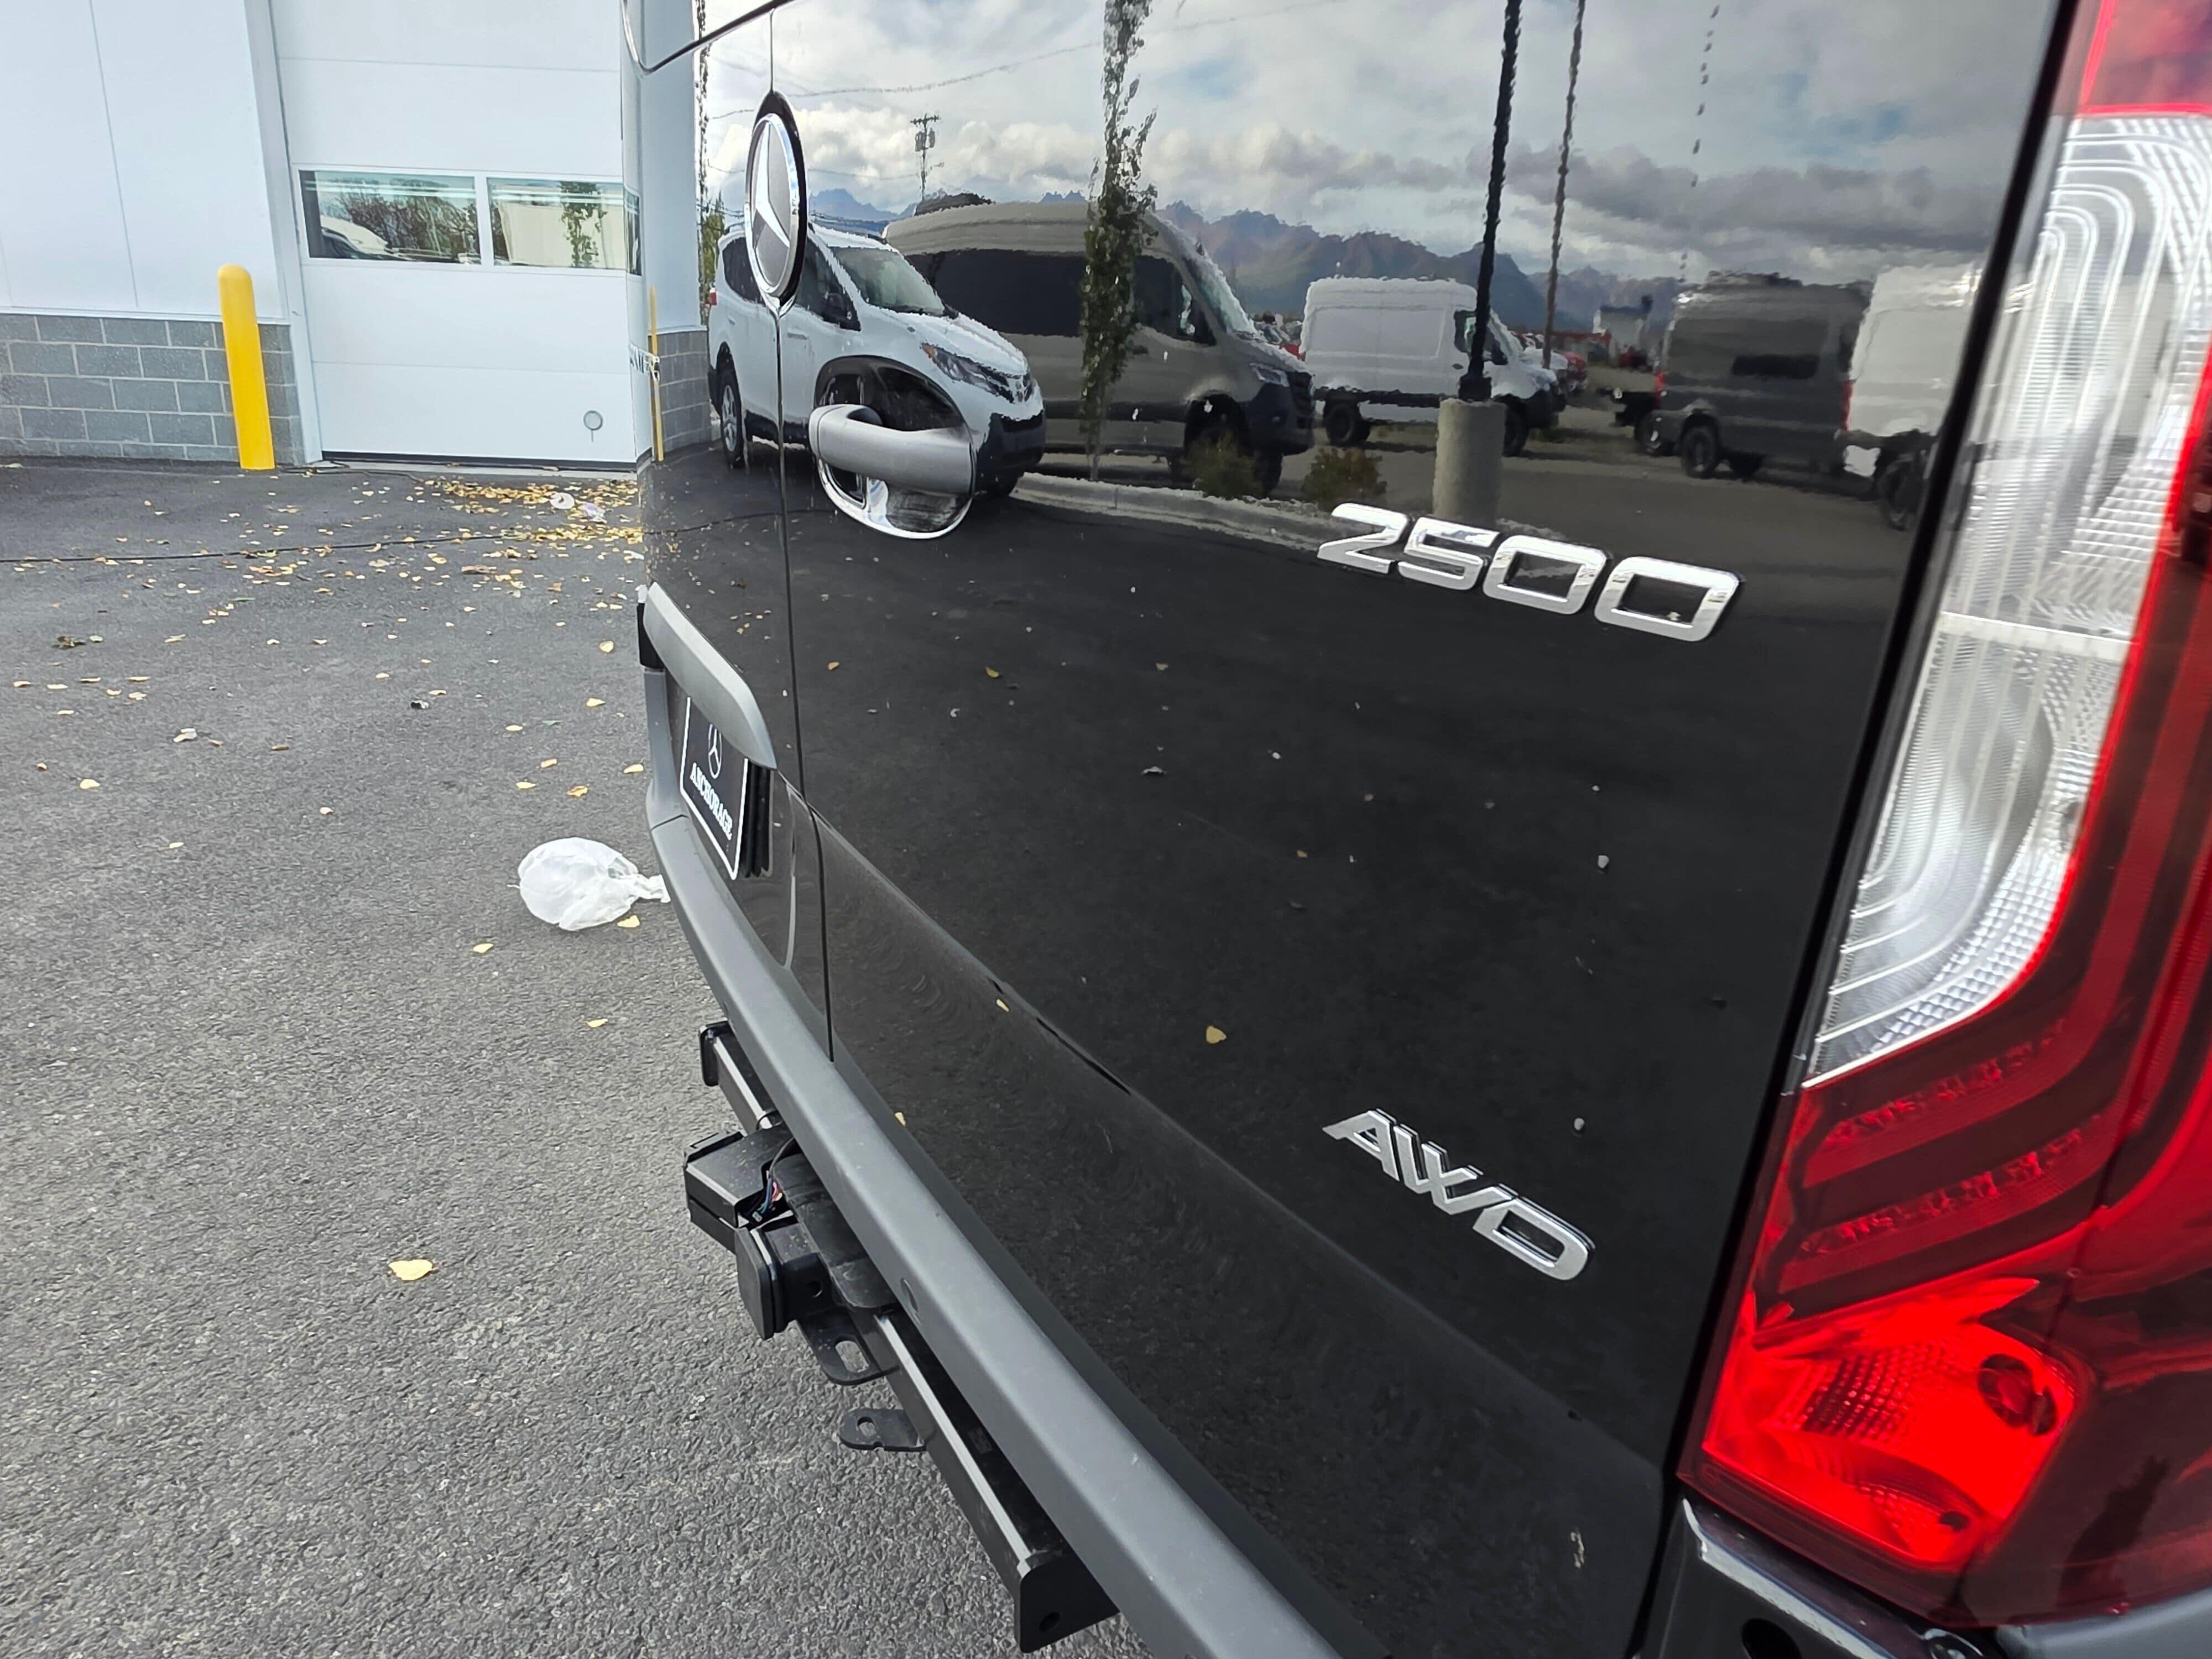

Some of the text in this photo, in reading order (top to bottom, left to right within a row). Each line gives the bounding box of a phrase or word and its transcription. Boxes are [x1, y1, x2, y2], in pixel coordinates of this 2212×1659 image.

[1316, 502, 1743, 642] 2500
[690, 762, 733, 841] ANCHORAGE
[1322, 1108, 1595, 1281] AWD
